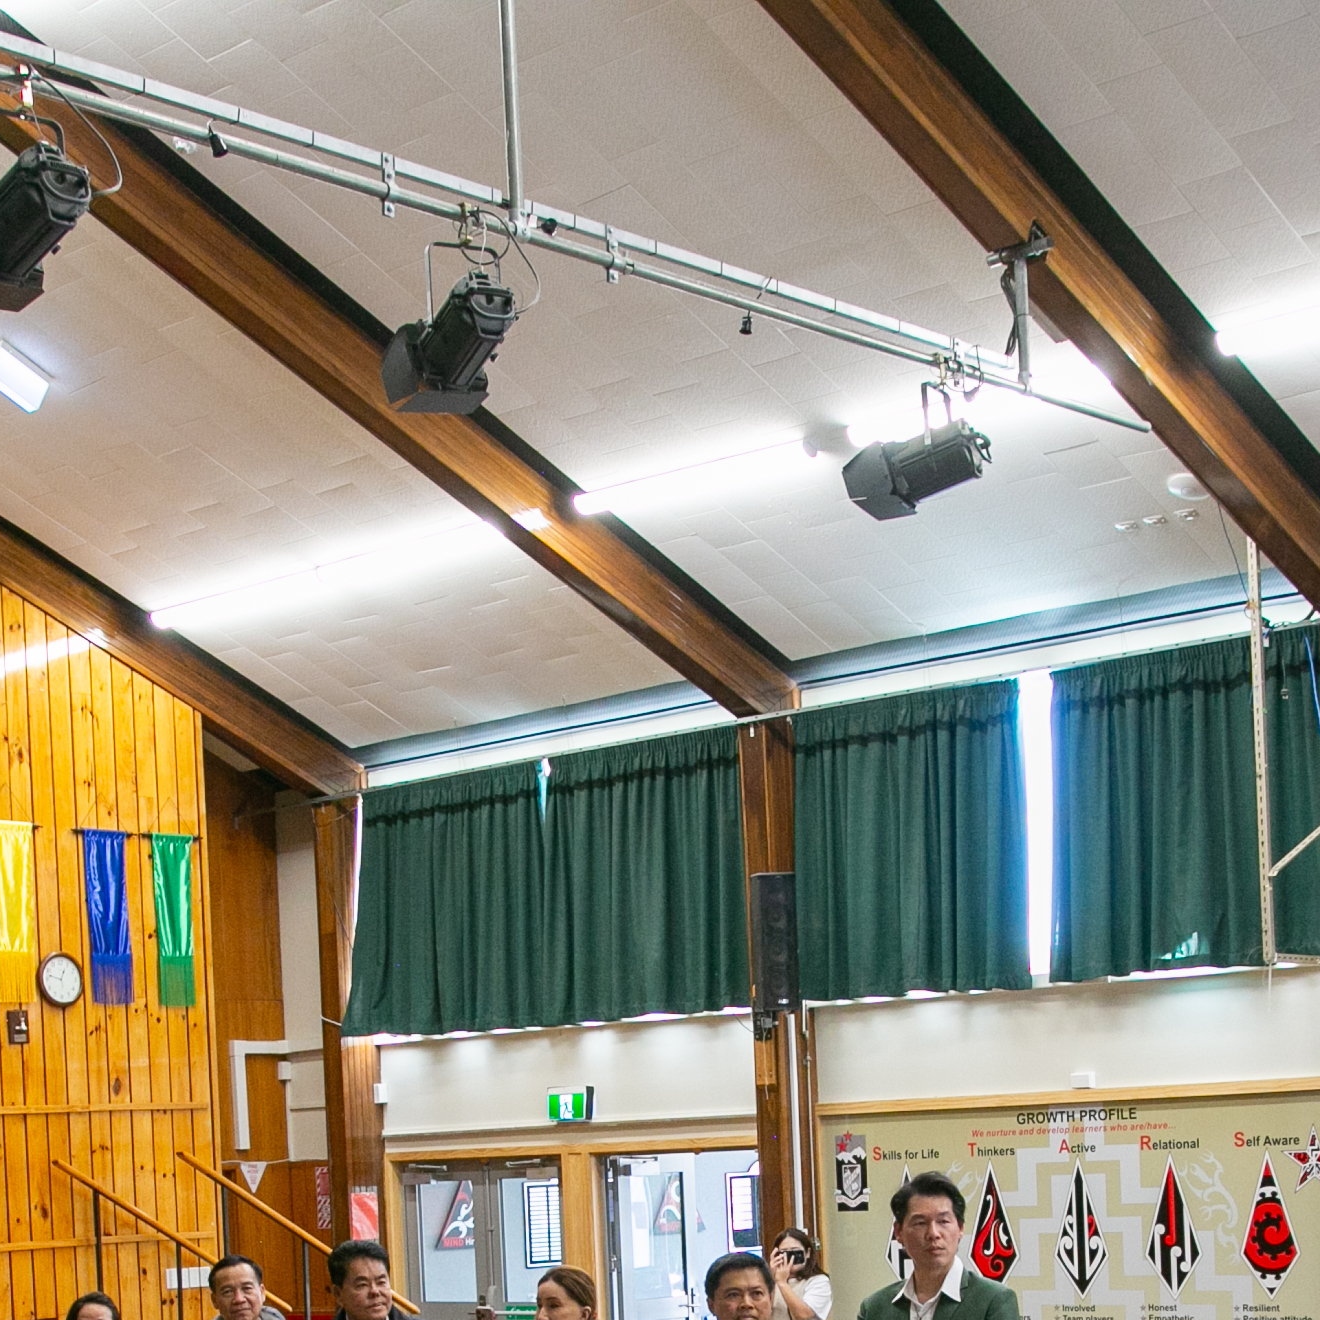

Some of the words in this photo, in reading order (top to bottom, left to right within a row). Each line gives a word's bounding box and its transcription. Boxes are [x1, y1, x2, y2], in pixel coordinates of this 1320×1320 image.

[1016, 1111, 1075, 1125] GROWTH
[1080, 1107, 1137, 1122] PROFILE
[972, 1130, 984, 1138] We
[986, 1129, 1016, 1137] nurture
[1019, 1127, 1034, 1136] and
[1036, 1126, 1070, 1136] develop
[1072, 1124, 1107, 1133] learners
[1110, 1123, 1128, 1132] who
[1059, 1139, 1096, 1154] Active
[1140, 1135, 1200, 1150] Relational
[1234, 1132, 1260, 1148] Self
[1263, 1135, 1300, 1146] Aware
[872, 1146, 902, 1162] Skills
[905, 1149, 918, 1160] for
[921, 1148, 940, 1160] Life
[967, 1142, 1015, 1157] Thinkers
[1062, 1304, 1096, 1312] Involved
[1148, 1304, 1177, 1312] Honest
[1242, 1304, 1280, 1312] Resilient
